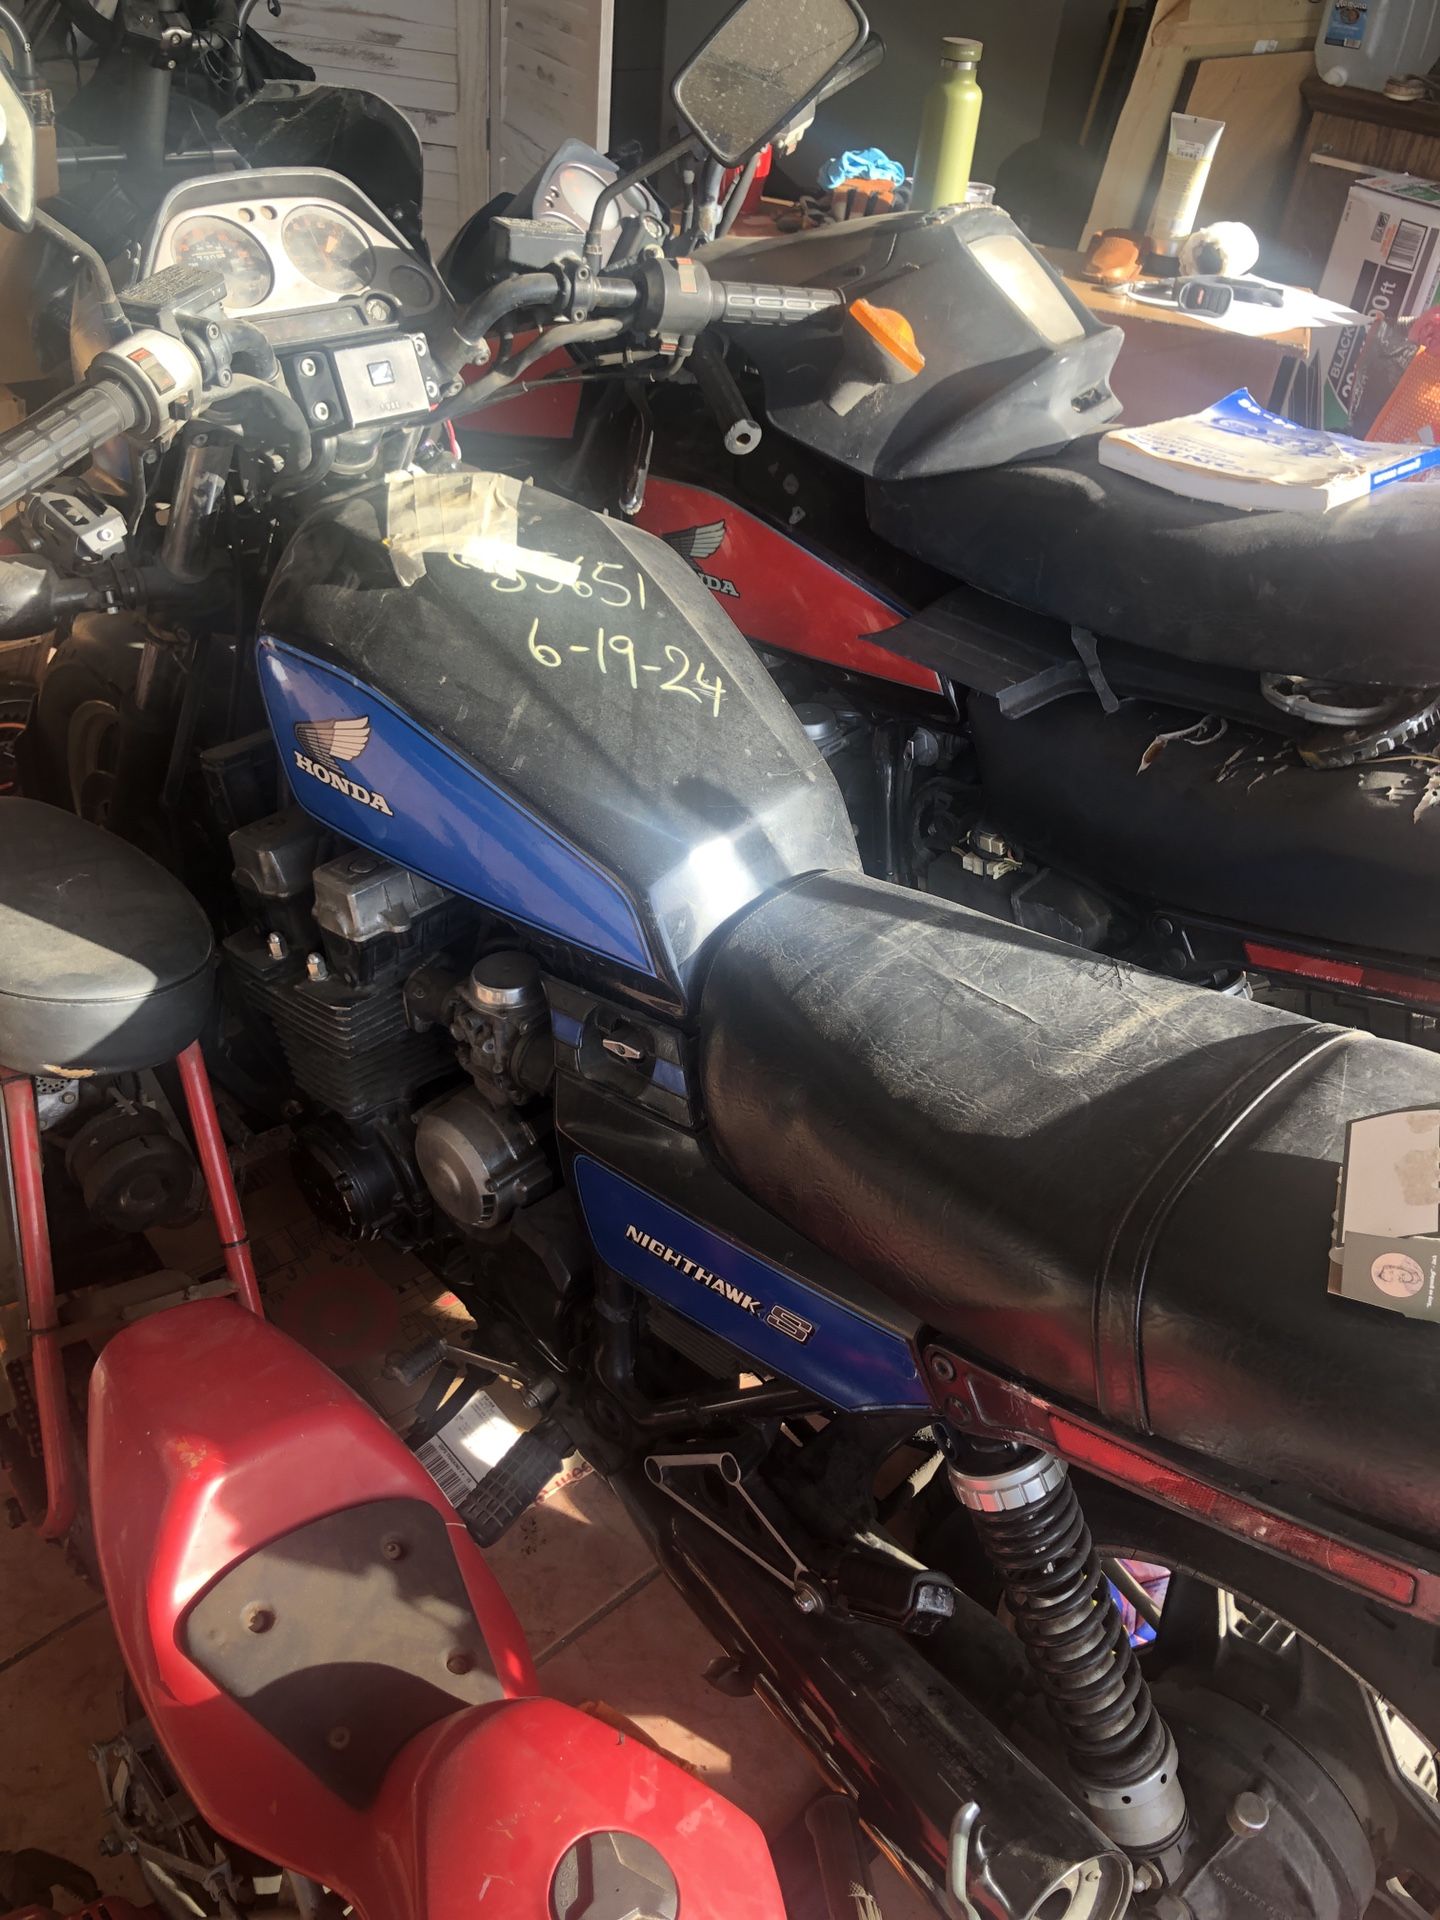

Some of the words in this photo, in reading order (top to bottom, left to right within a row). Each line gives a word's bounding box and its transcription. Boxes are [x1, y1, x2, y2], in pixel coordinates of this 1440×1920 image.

[528, 617, 727, 718] 6-19-24
[294, 750, 394, 816] HONDA
[626, 1224, 762, 1315] NIGHTHAWK
[766, 1304, 813, 1343] S
